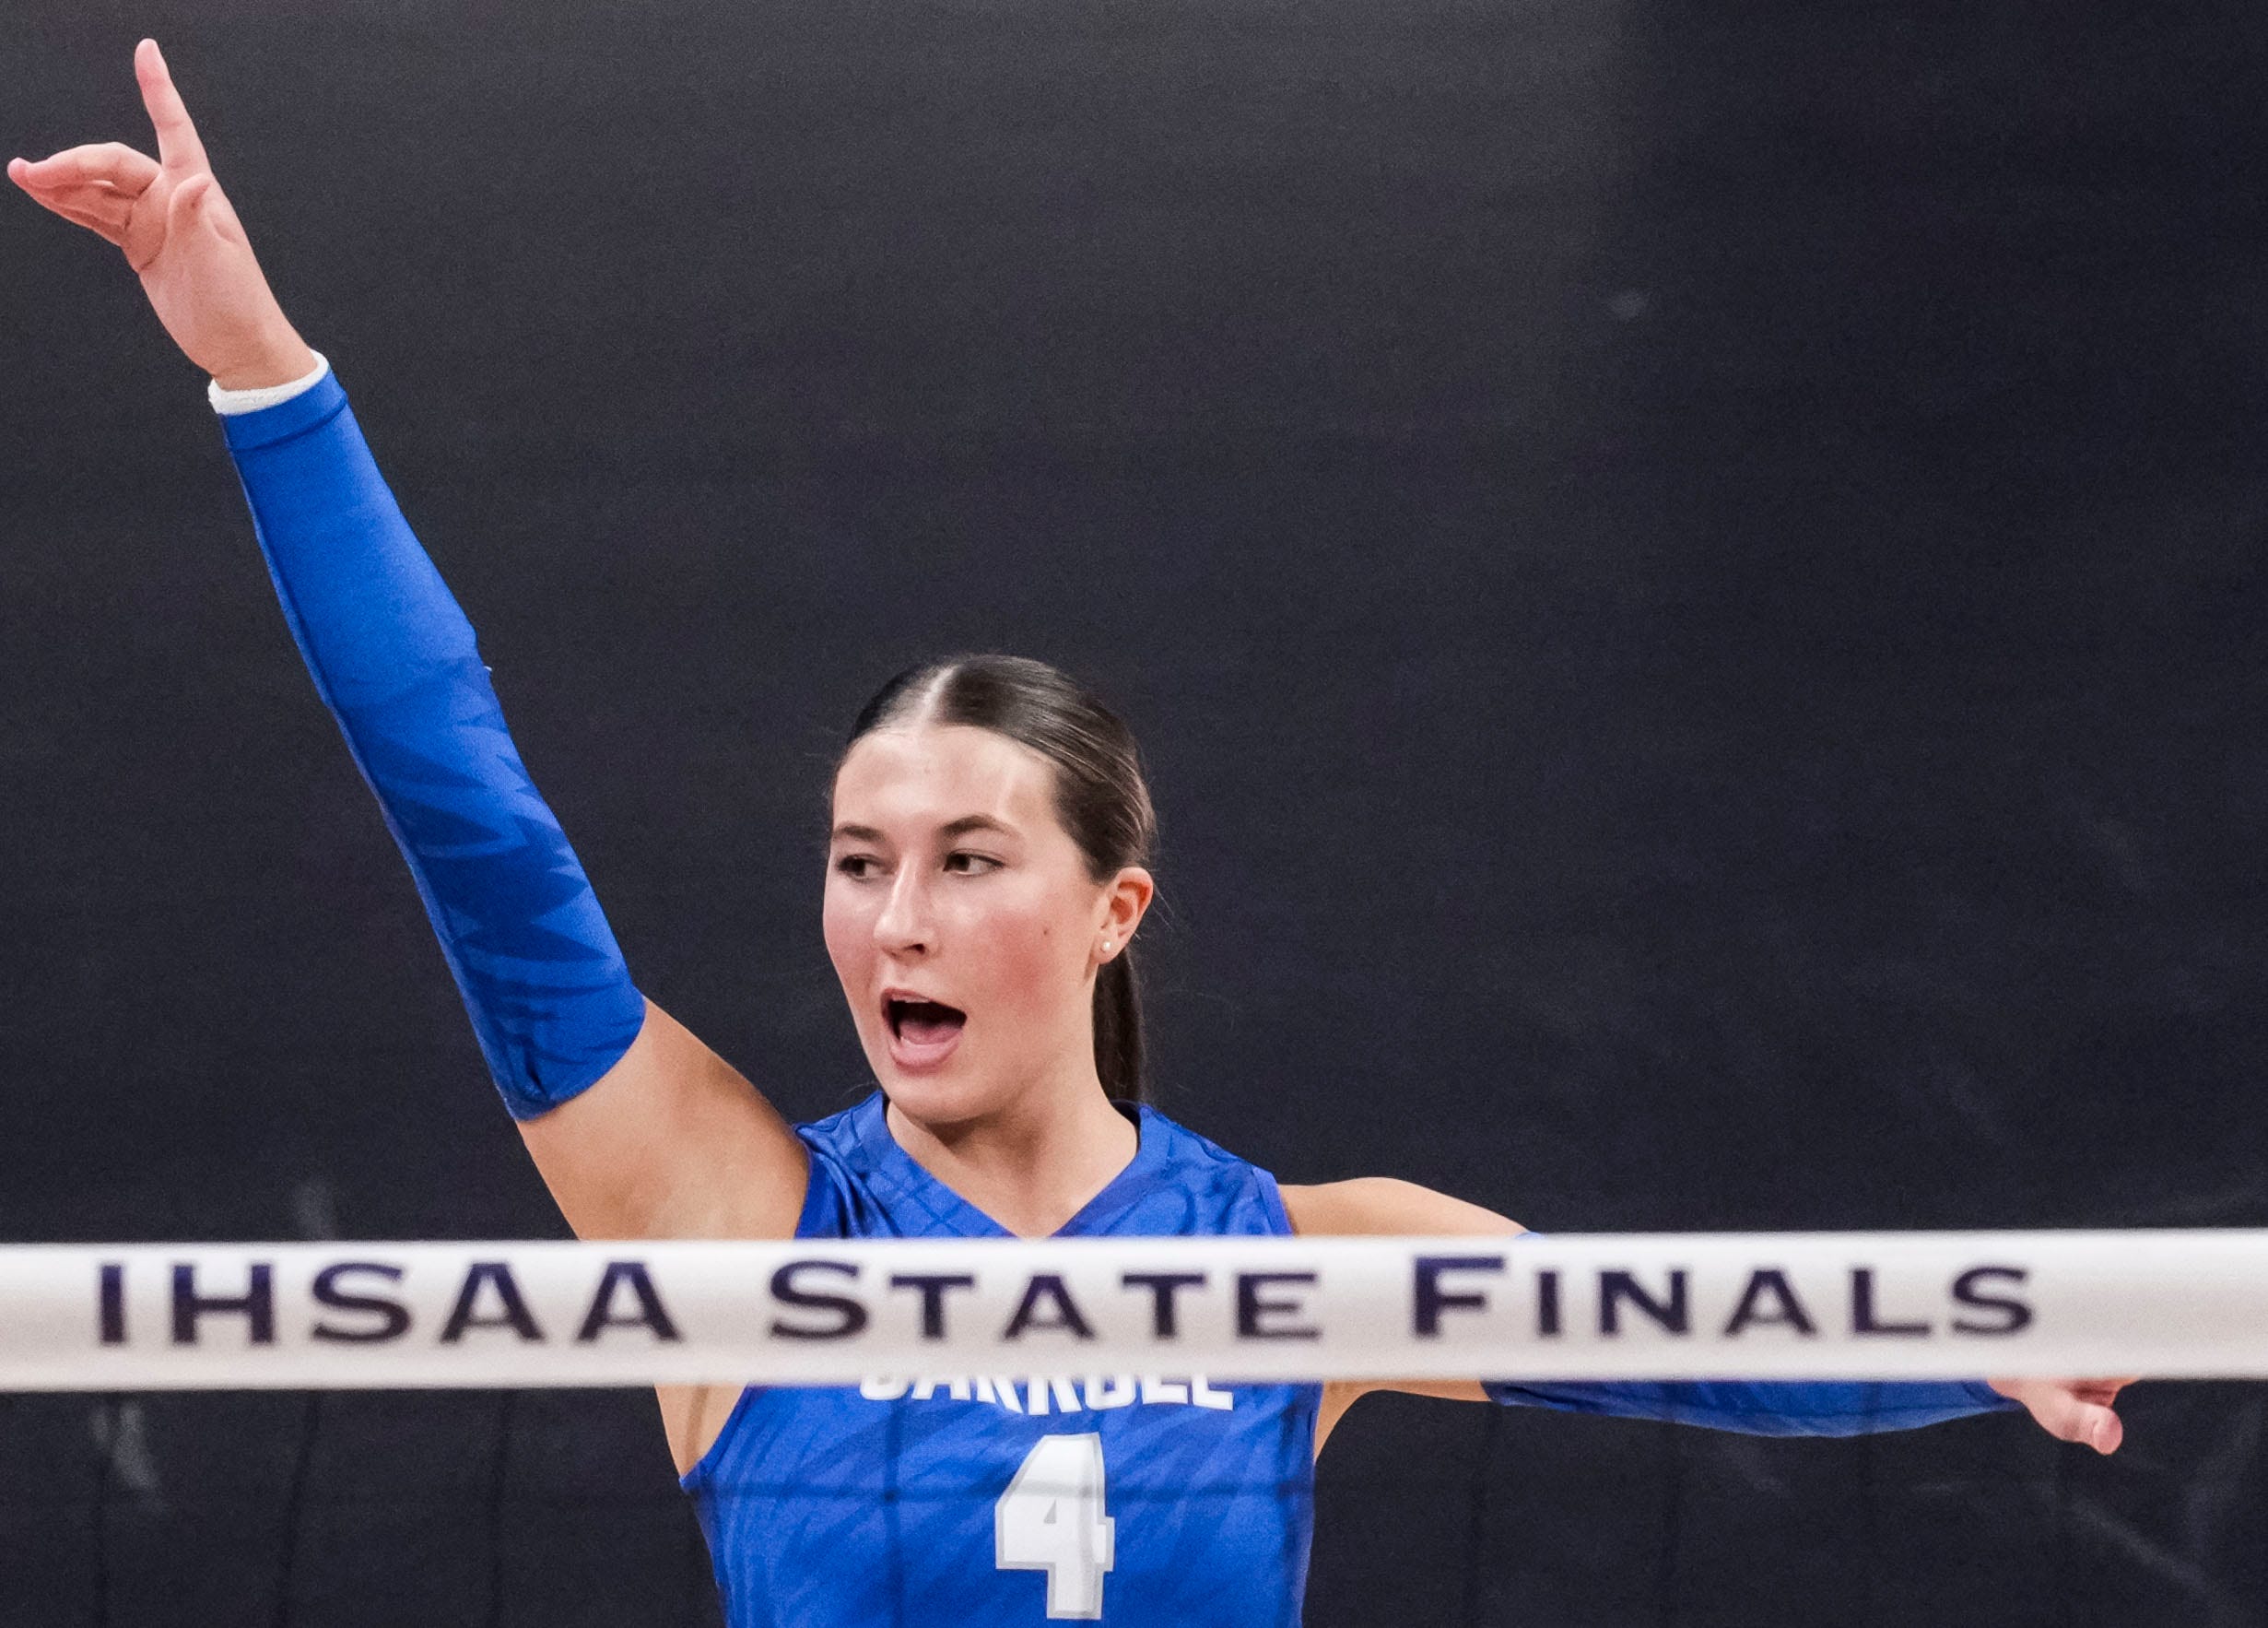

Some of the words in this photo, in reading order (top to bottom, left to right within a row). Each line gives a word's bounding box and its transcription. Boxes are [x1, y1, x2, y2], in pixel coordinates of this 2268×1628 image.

[97, 1259, 684, 1346] IHSAA
[767, 1257, 1324, 1341] STATE
[1411, 1255, 2036, 1339] FINALS
[994, 1431, 1116, 1621] 4
